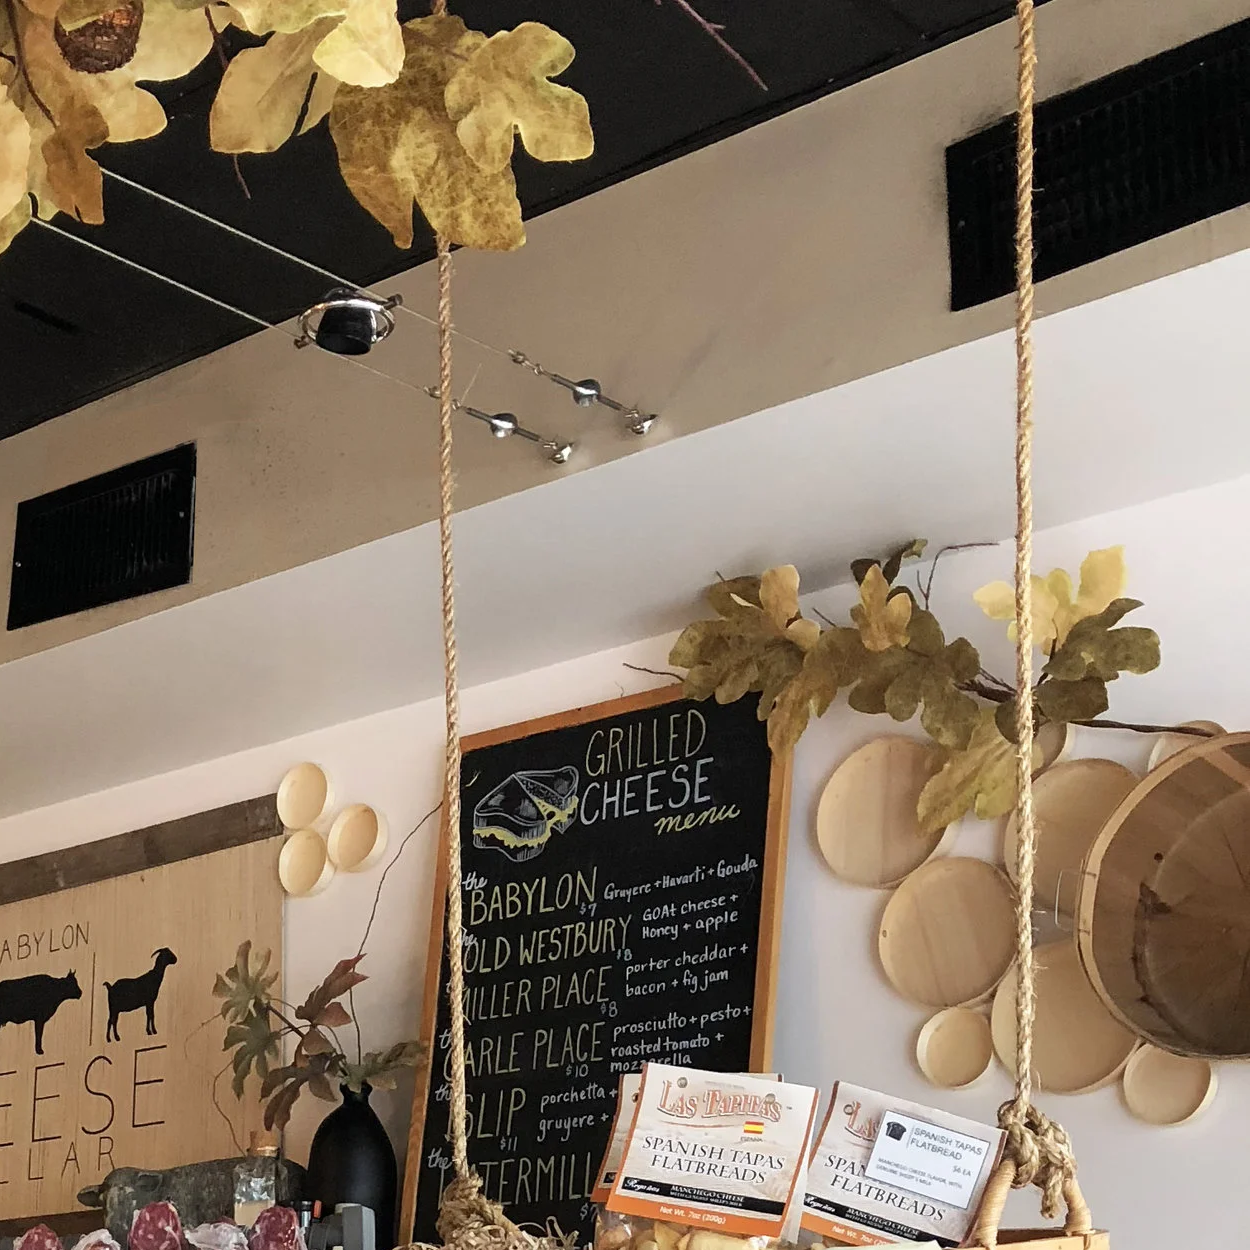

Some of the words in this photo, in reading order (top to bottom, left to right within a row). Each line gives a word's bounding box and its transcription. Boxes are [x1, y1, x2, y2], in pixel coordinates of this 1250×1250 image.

[585, 709, 707, 777] GRILLED
[580, 757, 714, 826] CHEESE
[654, 802, 741, 836] menu
[461, 871, 488, 891] the
[661, 865, 705, 889] Havarti
[716, 855, 758, 880] Gouda
[470, 866, 598, 927] BABYLON
[578, 902, 598, 918] $7
[680, 896, 727, 917] cheese
[642, 920, 680, 941] Honey
[695, 909, 740, 933] apple
[462, 935, 512, 975] OLD
[519, 914, 633, 967] WESTBURY
[616, 948, 633, 962] $8
[625, 957, 671, 981] porter
[674, 946, 737, 968] cheddar
[540, 965, 613, 1011] PLACE
[625, 979, 667, 999] bacon
[682, 973, 699, 995] fig
[699, 967, 729, 993] jam
[599, 1001, 619, 1018] $8
[612, 1011, 688, 1042] prosciutto
[699, 1005, 742, 1029] pesto
[532, 1021, 606, 1072] PLACE
[610, 1035, 661, 1058] roasted
[663, 1034, 711, 1051] tomato
[565, 1064, 589, 1079] $10
[540, 1082, 606, 1114] porchetta
[536, 1112, 595, 1143] gruyere
[913, 1127, 953, 1147] SPANISH
[954, 1139, 983, 1157] TAPAS
[642, 1135, 725, 1163] SPANISH
[730, 1148, 786, 1172] TAPAS
[910, 1137, 963, 1161] FLATBREAD
[438, 1151, 593, 1210] TERMILL
[651, 1154, 767, 1185] FLATBREADS
[659, 1205, 673, 1215] Net
[830, 1174, 946, 1222] FLATBREADS
